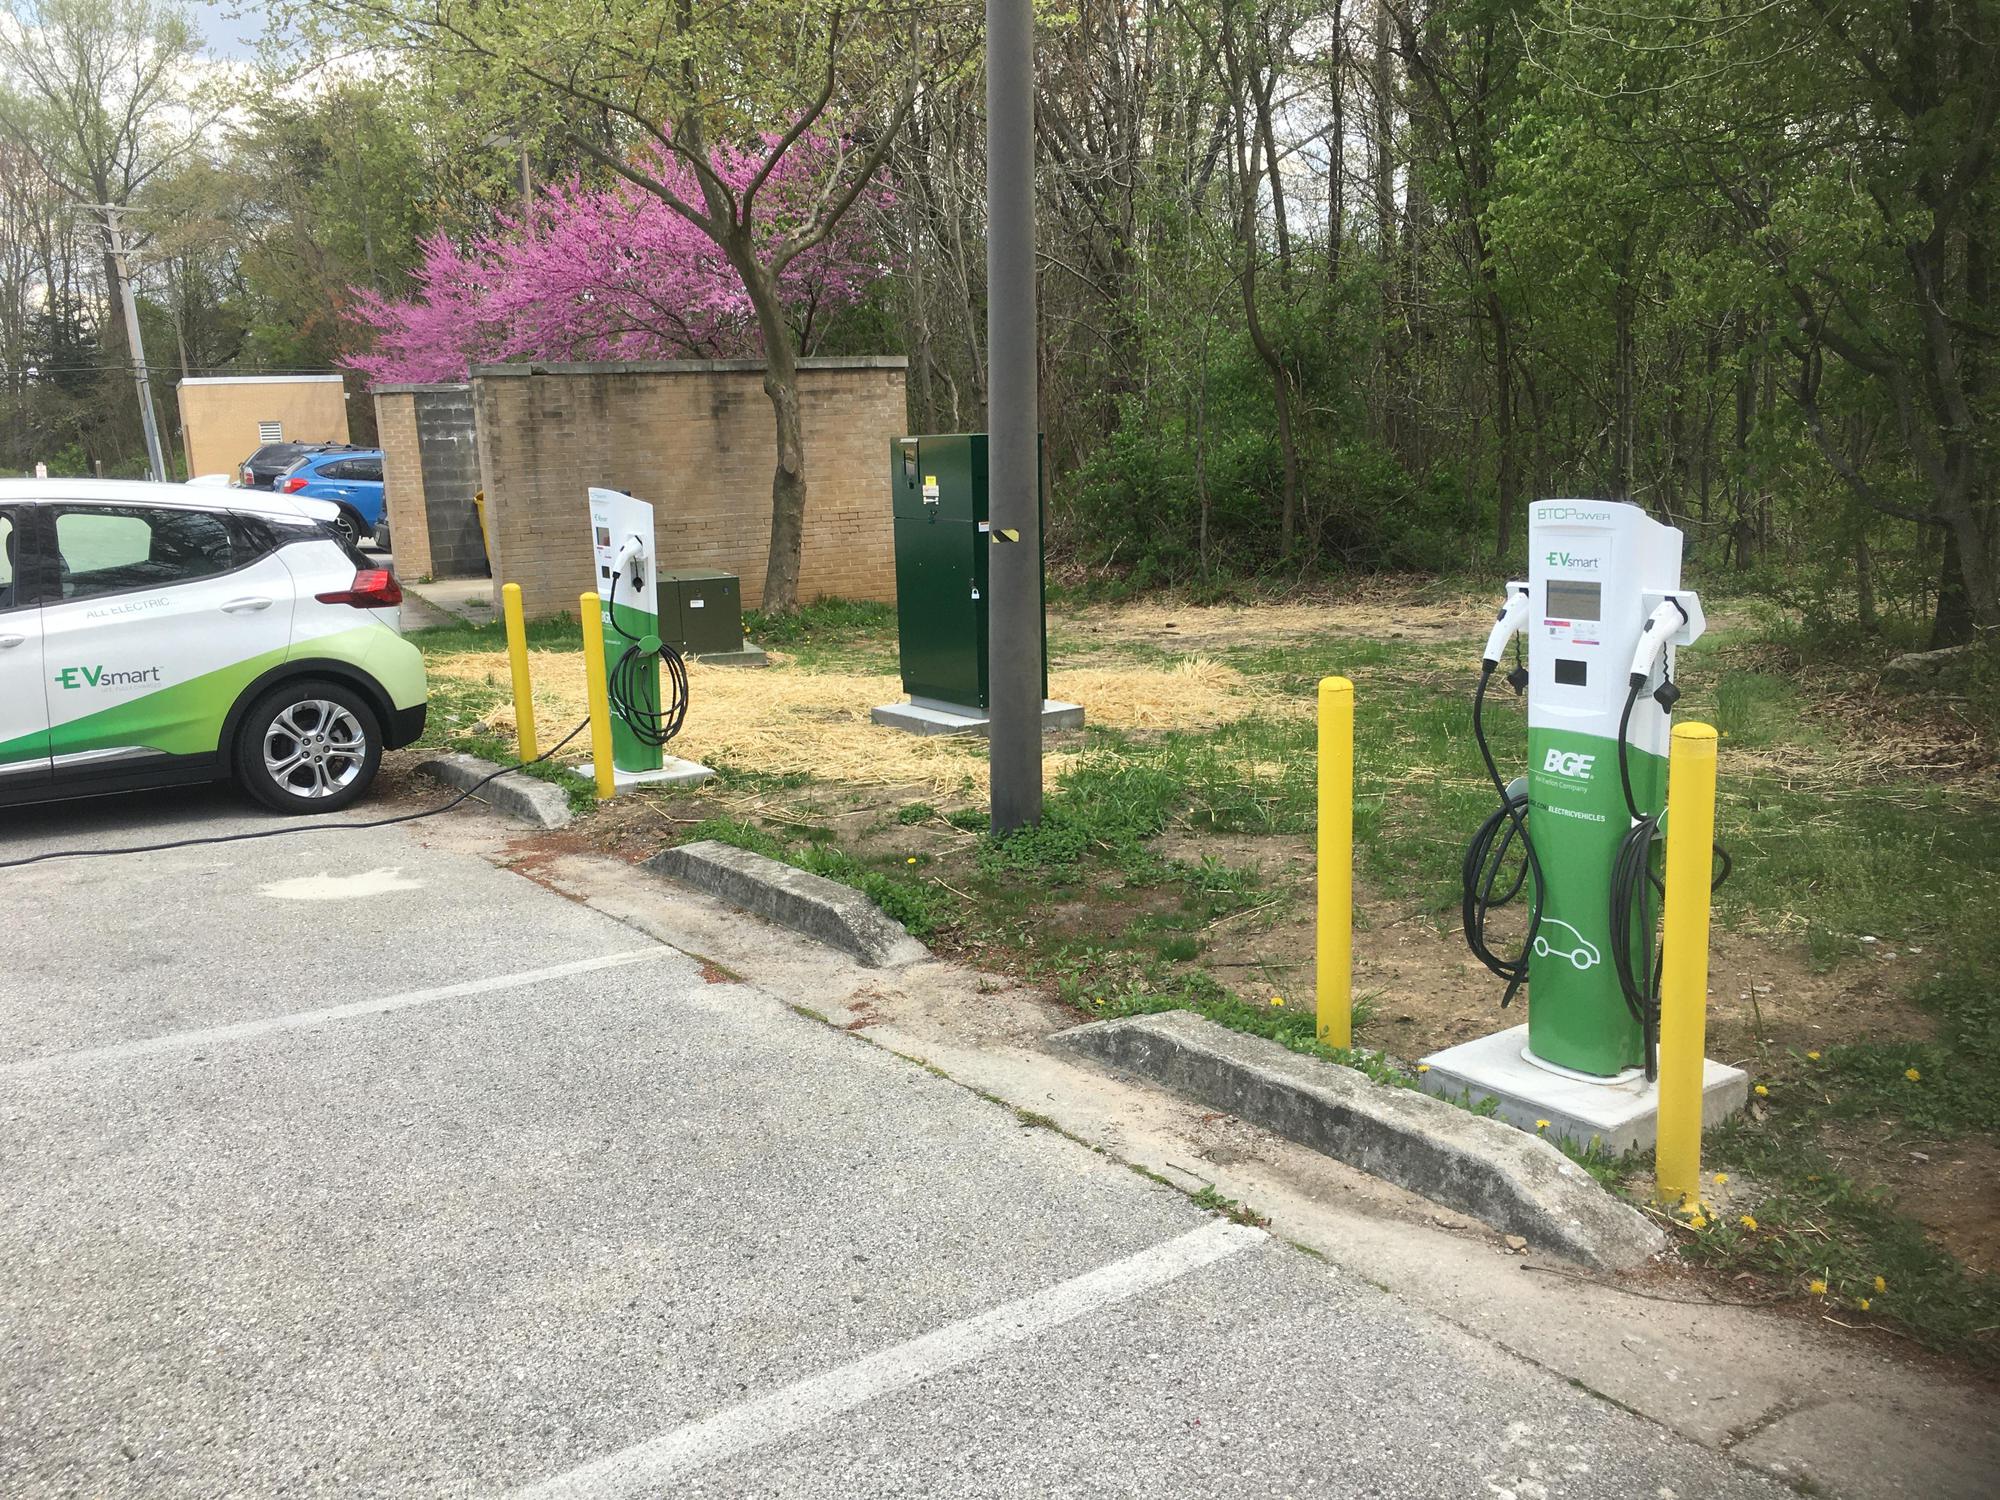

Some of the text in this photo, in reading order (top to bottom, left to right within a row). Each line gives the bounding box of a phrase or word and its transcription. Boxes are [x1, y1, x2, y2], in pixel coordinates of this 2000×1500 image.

[86, 609, 109, 620] ALL
[54, 665, 160, 690] EVsmart
[1543, 748, 1596, 778] BGE
[1559, 781, 1587, 794] Company
